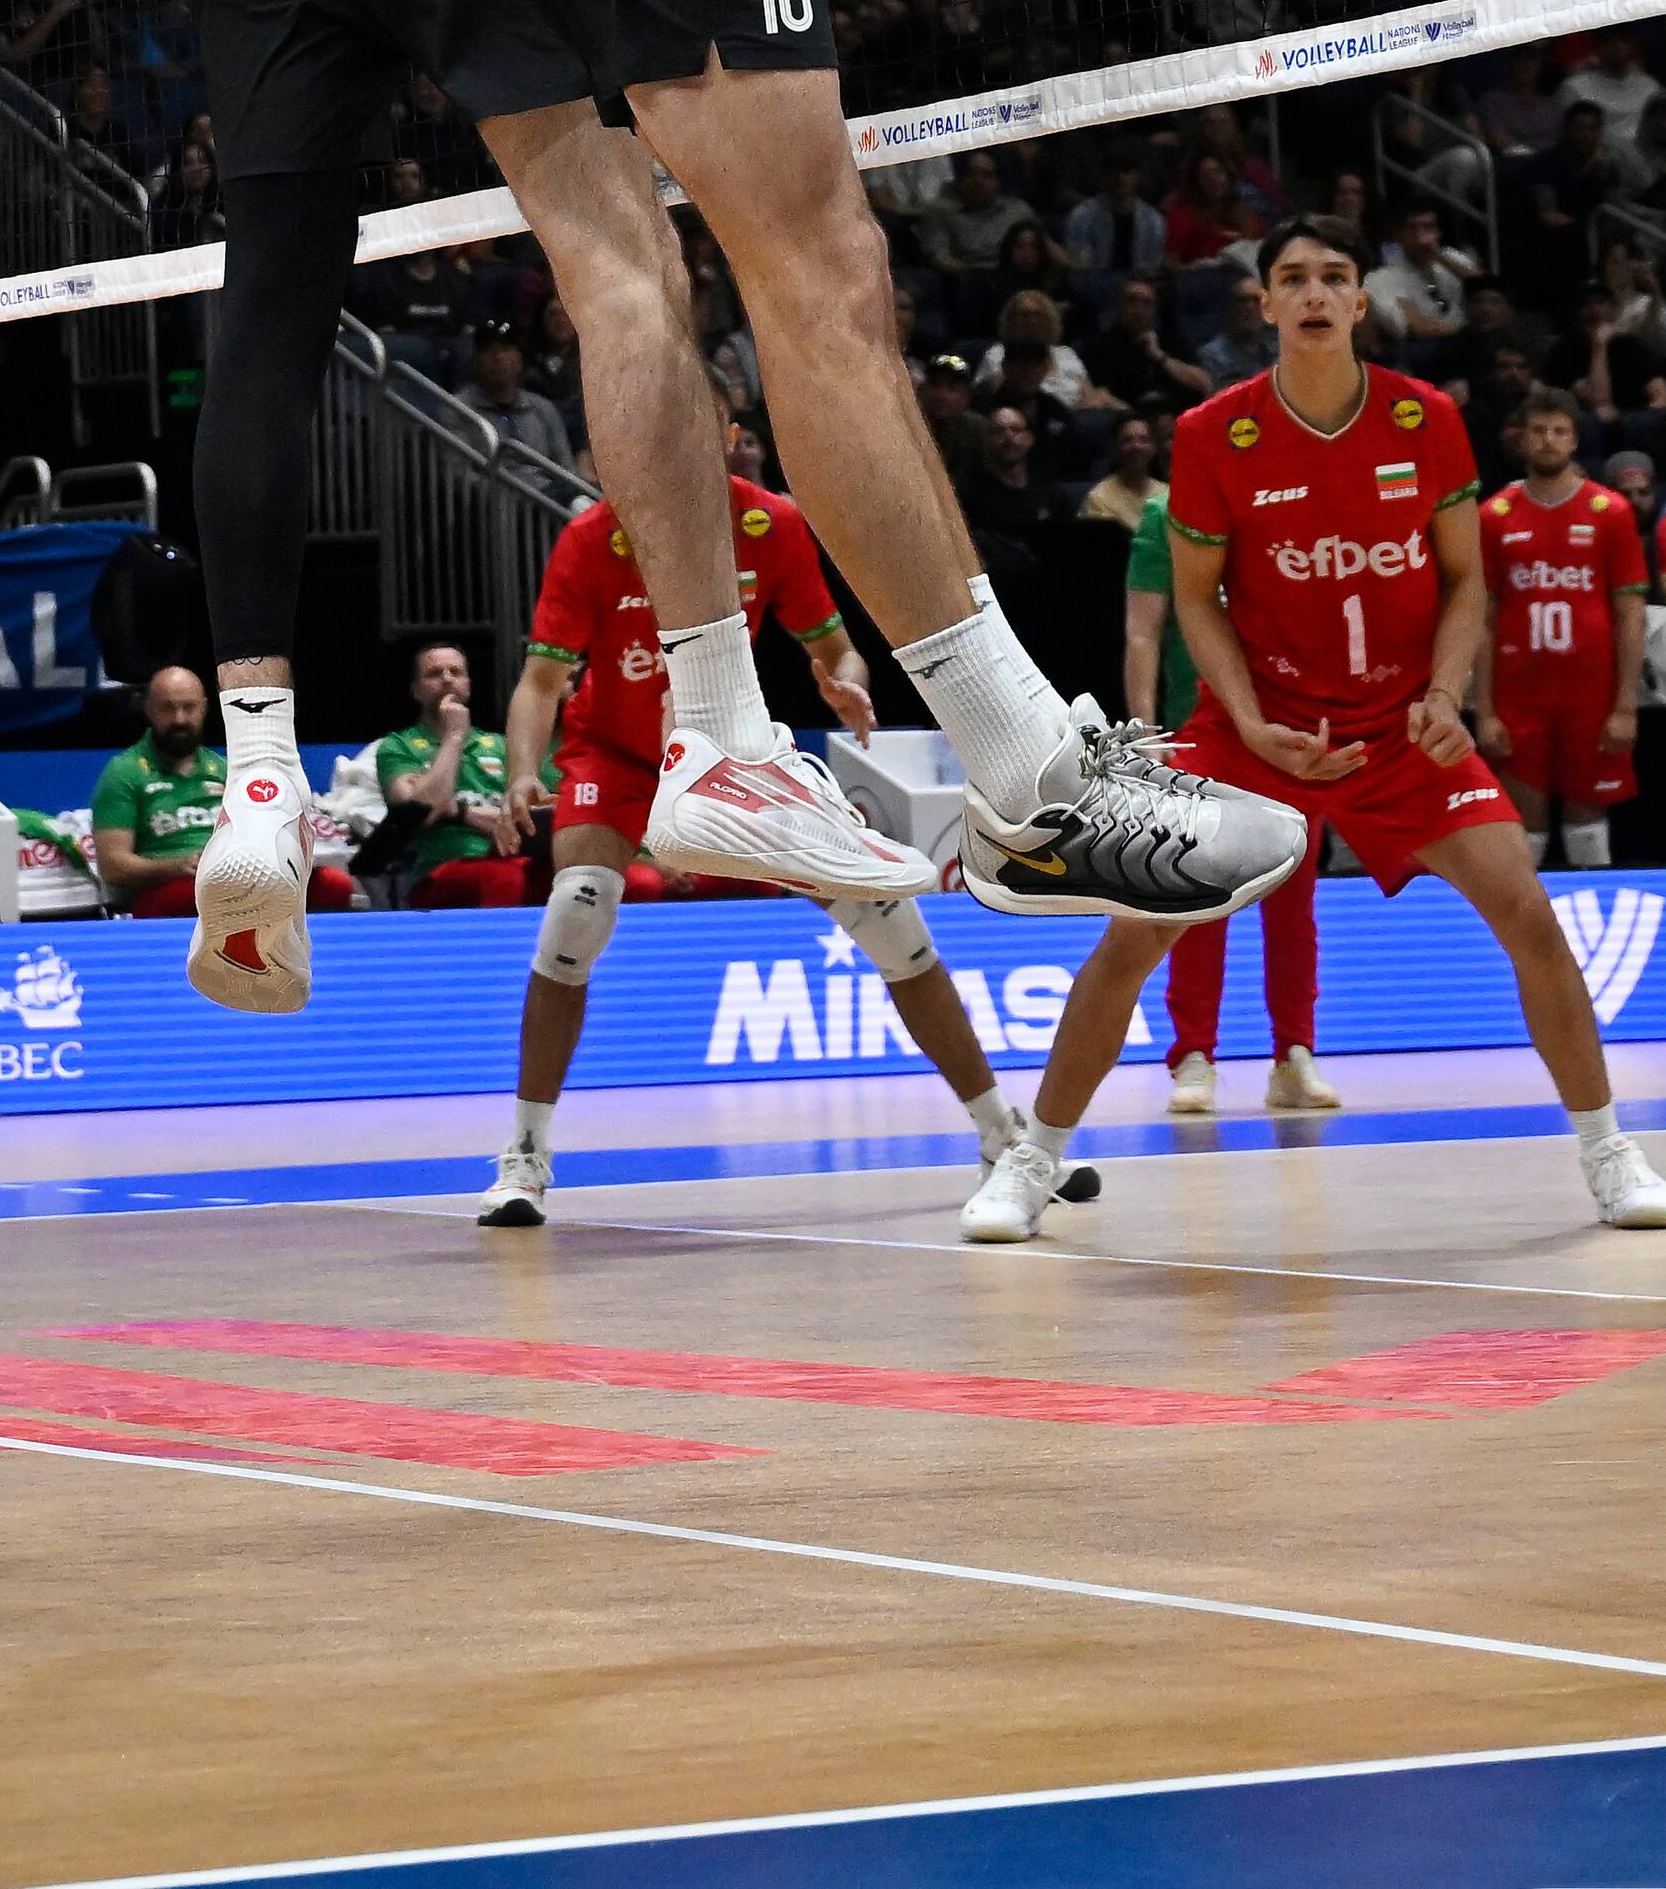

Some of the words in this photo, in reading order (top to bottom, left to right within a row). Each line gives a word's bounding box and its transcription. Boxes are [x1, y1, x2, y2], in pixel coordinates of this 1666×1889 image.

[1388, 23, 1421, 39] NATIONS
[1389, 36, 1419, 51] LEAGUE
[1254, 48, 1277, 79] VNL
[1282, 32, 1387, 71] VOLLEYBALL
[882, 111, 970, 146] VOLLEYBALL
[1252, 485, 1310, 507] Zeus
[1276, 529, 1427, 581] efbet
[1512, 560, 1594, 591] efbet
[1343, 593, 1367, 676] 1
[1528, 600, 1573, 653] 10
[574, 782, 599, 808] 18
